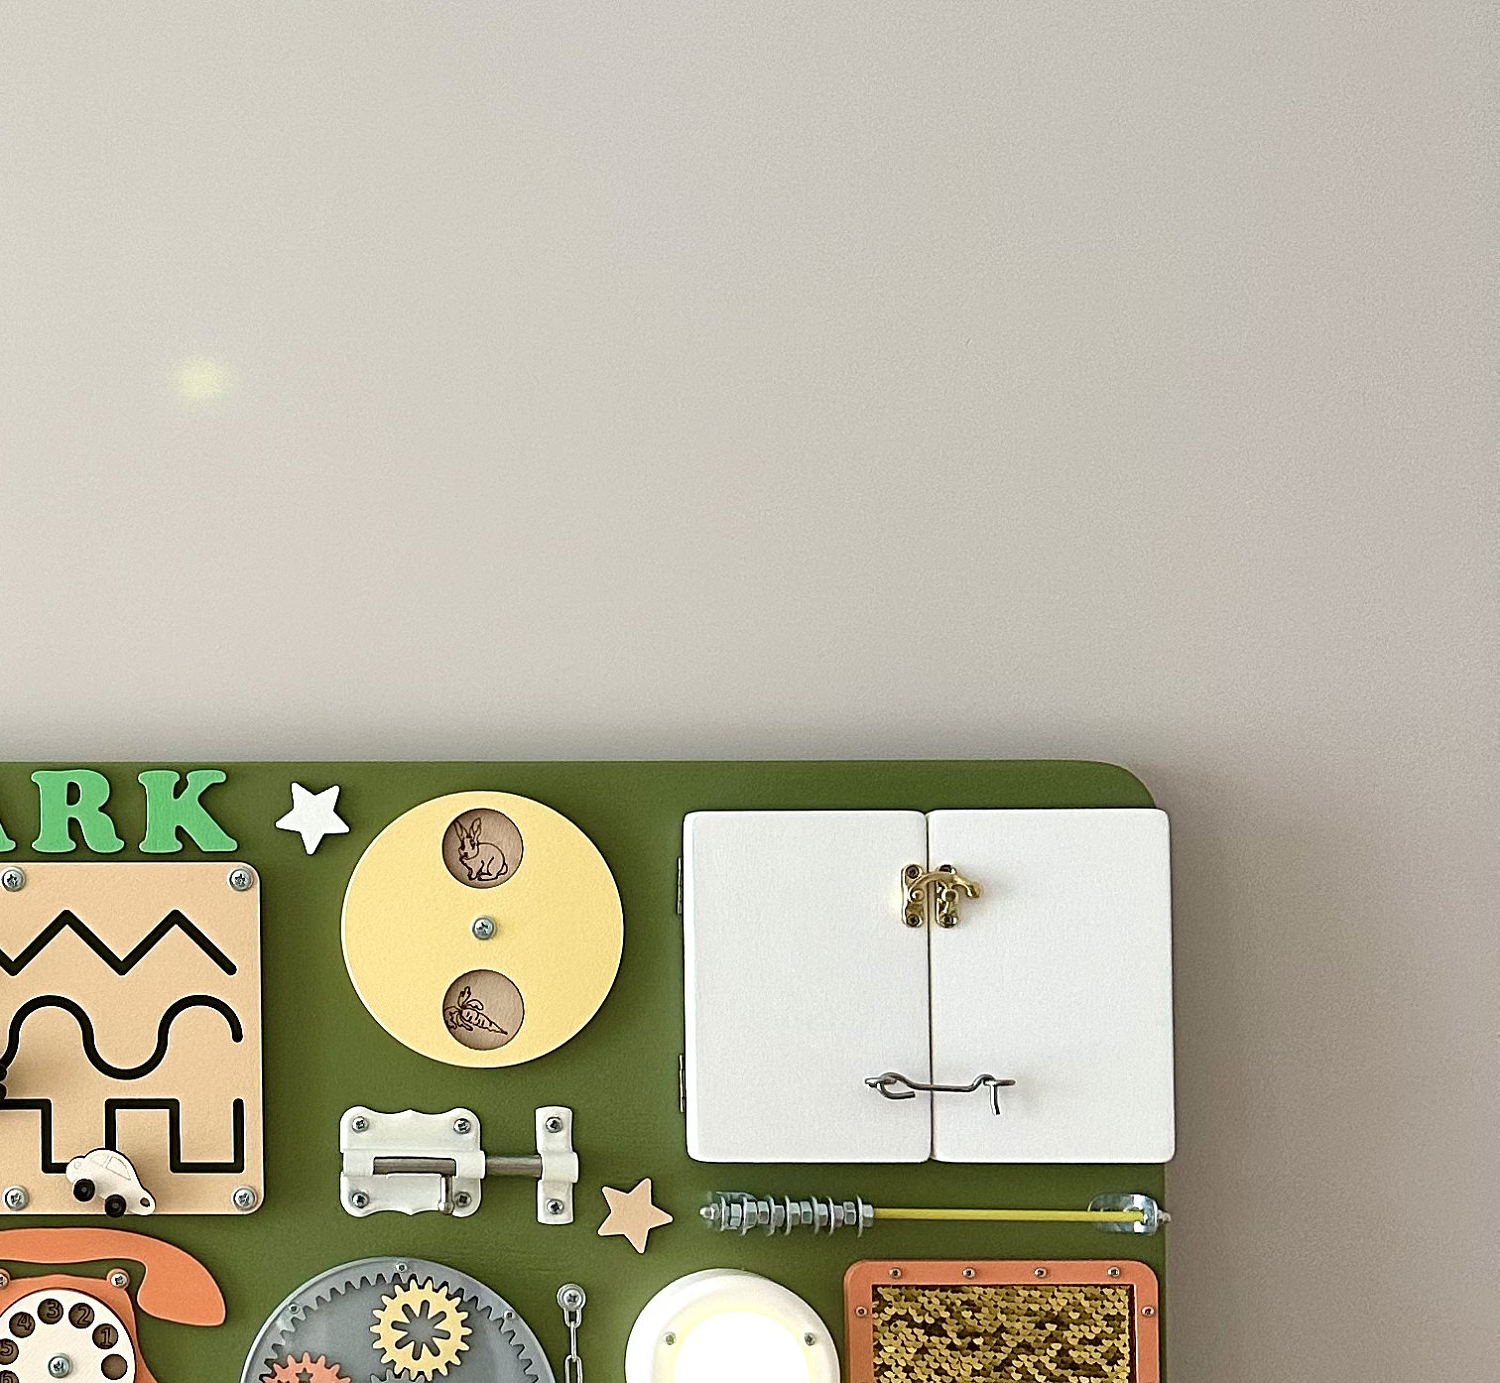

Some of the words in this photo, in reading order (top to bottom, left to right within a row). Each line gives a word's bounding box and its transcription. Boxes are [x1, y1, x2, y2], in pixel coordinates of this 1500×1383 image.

[46, 1301, 60, 1318] 3
[77, 1306, 91, 1325] 2
[17, 1314, 32, 1331] 4
[100, 1327, 112, 1346] 1
[0, 1340, 14, 1357] 5
